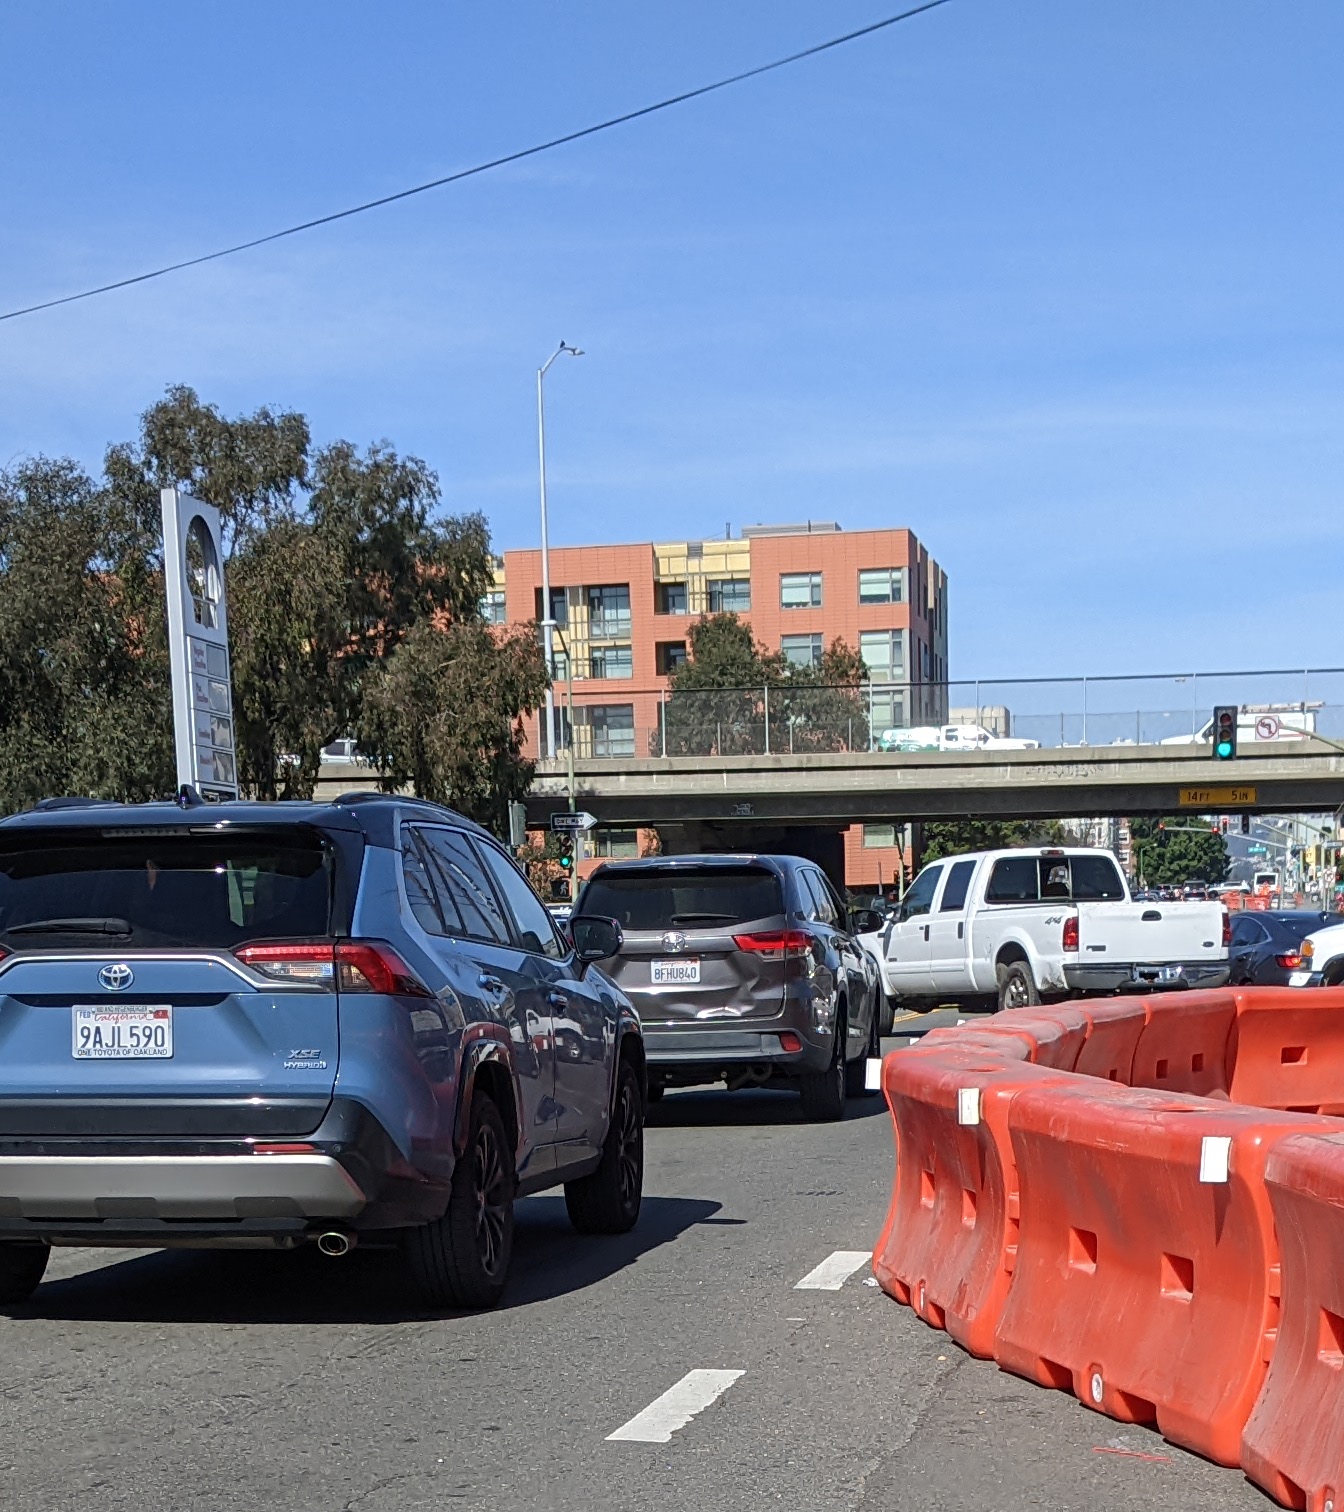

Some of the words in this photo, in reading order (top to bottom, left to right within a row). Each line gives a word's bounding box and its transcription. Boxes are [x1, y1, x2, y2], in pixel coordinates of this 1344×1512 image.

[654, 966, 697, 981] 8FHU840
[80, 1025, 165, 1048] 9AJL590
[288, 1049, 321, 1059] XSE
[283, 1061, 320, 1069] HYBRID
